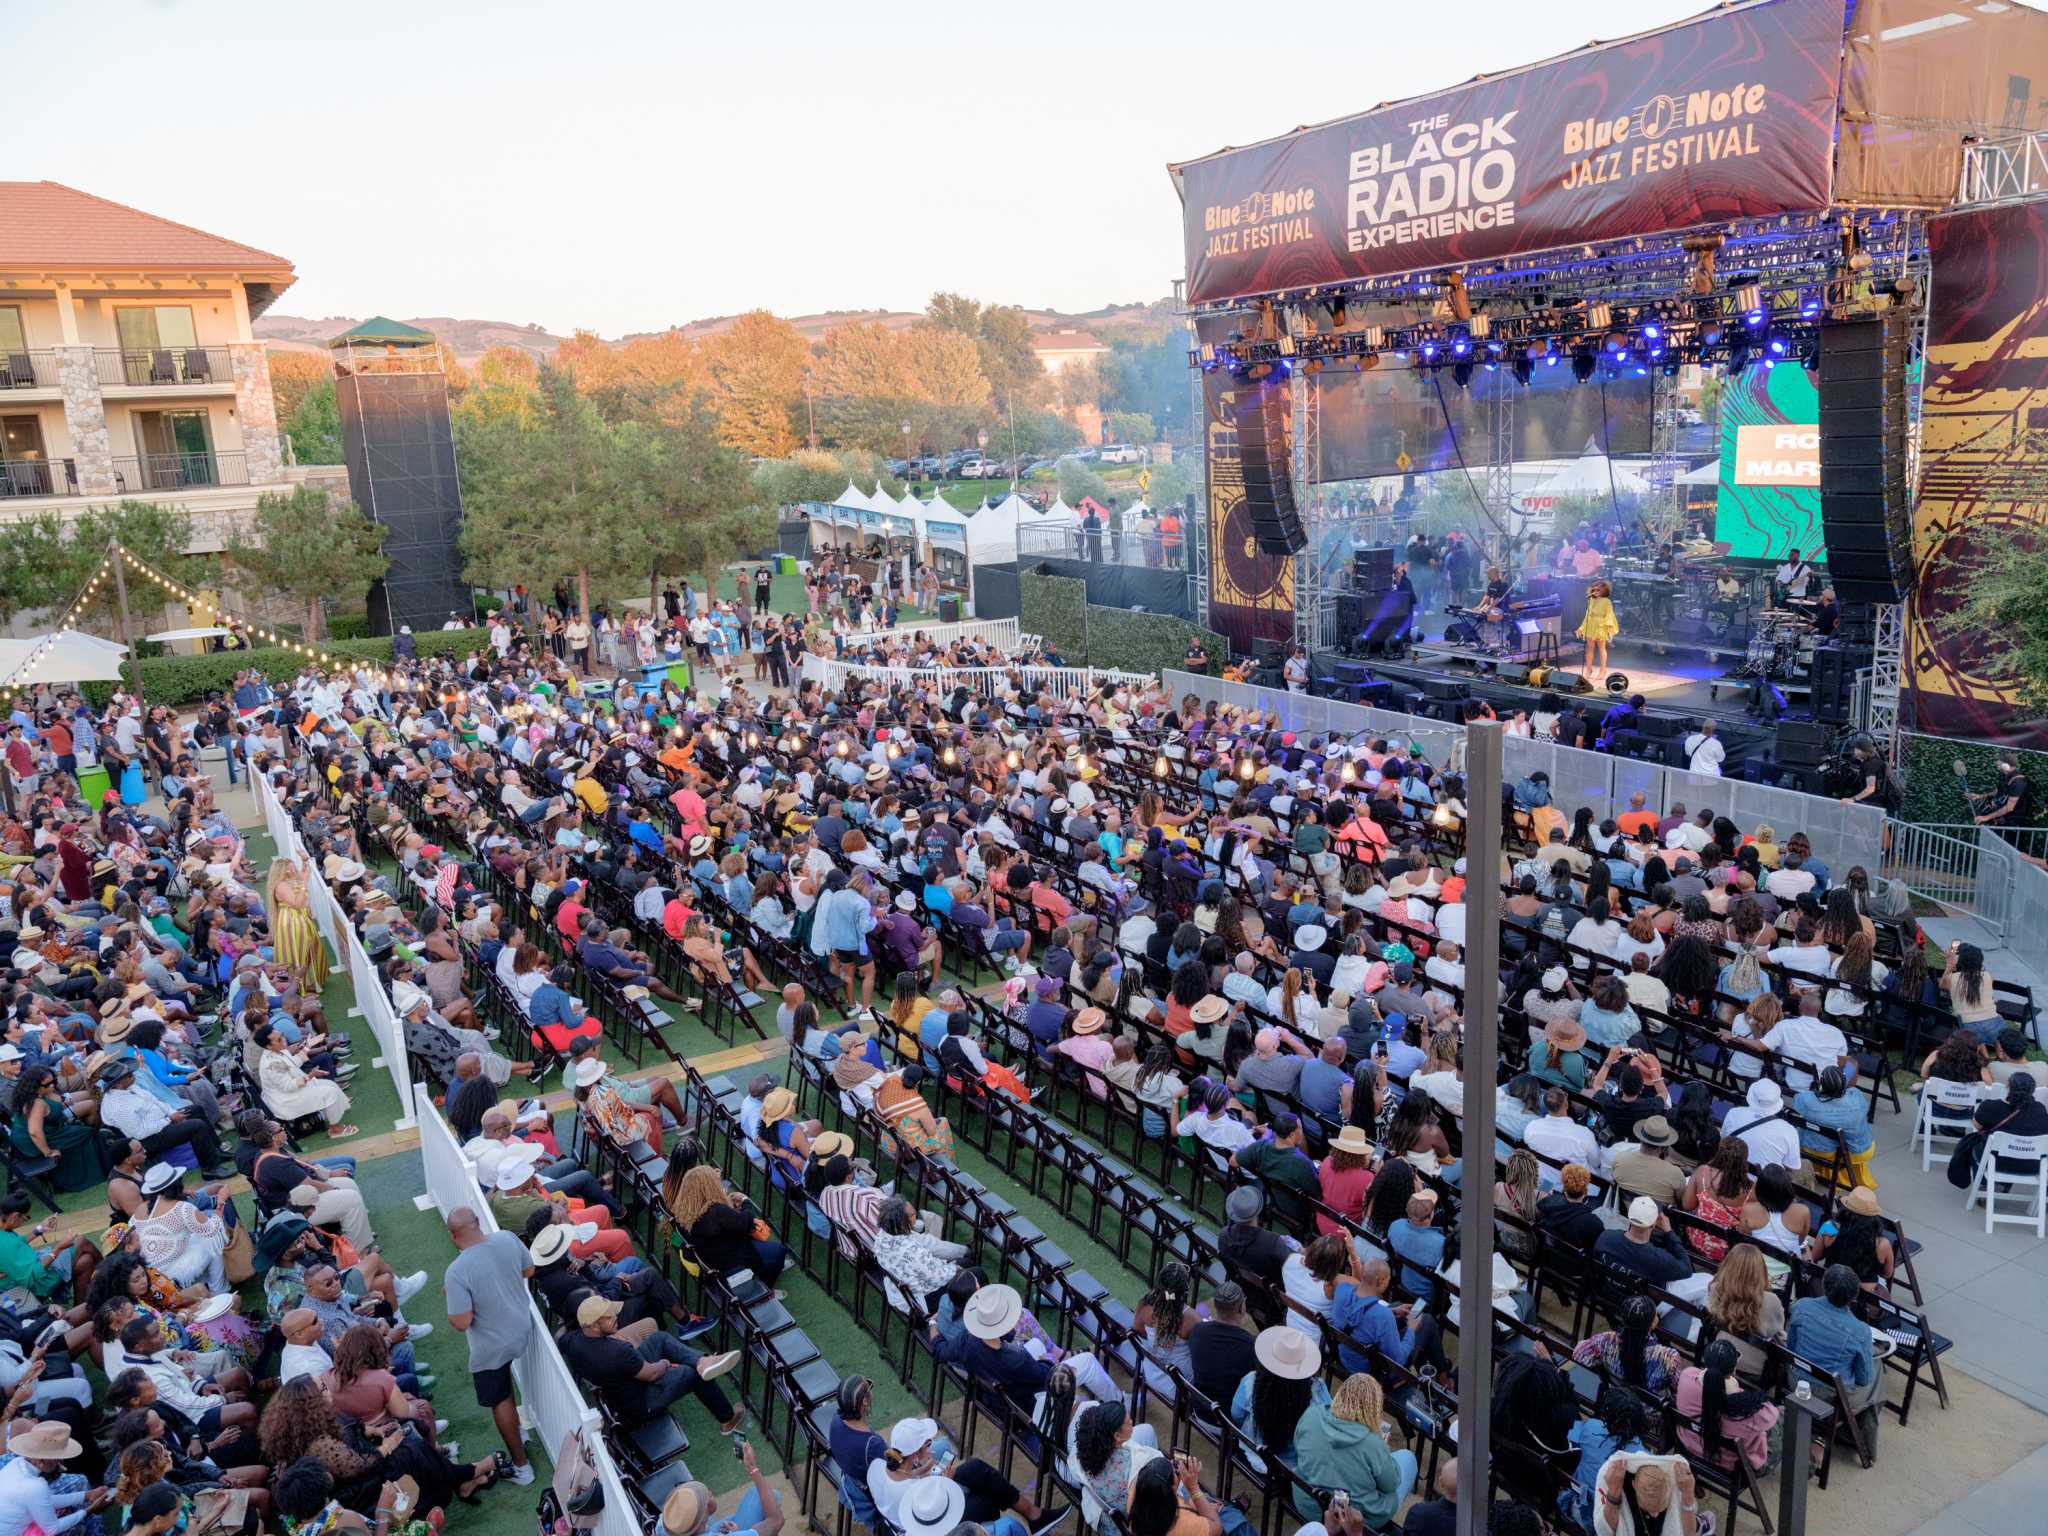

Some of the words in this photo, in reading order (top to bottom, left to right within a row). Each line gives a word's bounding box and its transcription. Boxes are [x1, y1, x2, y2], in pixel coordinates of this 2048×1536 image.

[1408, 114, 1449, 135] THE
[1563, 116, 1630, 155] Blue
[1686, 83, 1766, 127] Note
[1349, 110, 1519, 181] BLACK
[1562, 152, 1622, 190] JAZZ
[1631, 124, 1765, 176] FESTIVAL
[1205, 205, 1240, 231] Blue
[1272, 187, 1314, 217] Note
[1347, 149, 1516, 229] RADIO
[1206, 231, 1239, 257] JAZZ
[1243, 217, 1313, 250] FESTIVAL
[1347, 201, 1515, 252] EXPERIENCE
[1745, 461, 1821, 477] MAR
